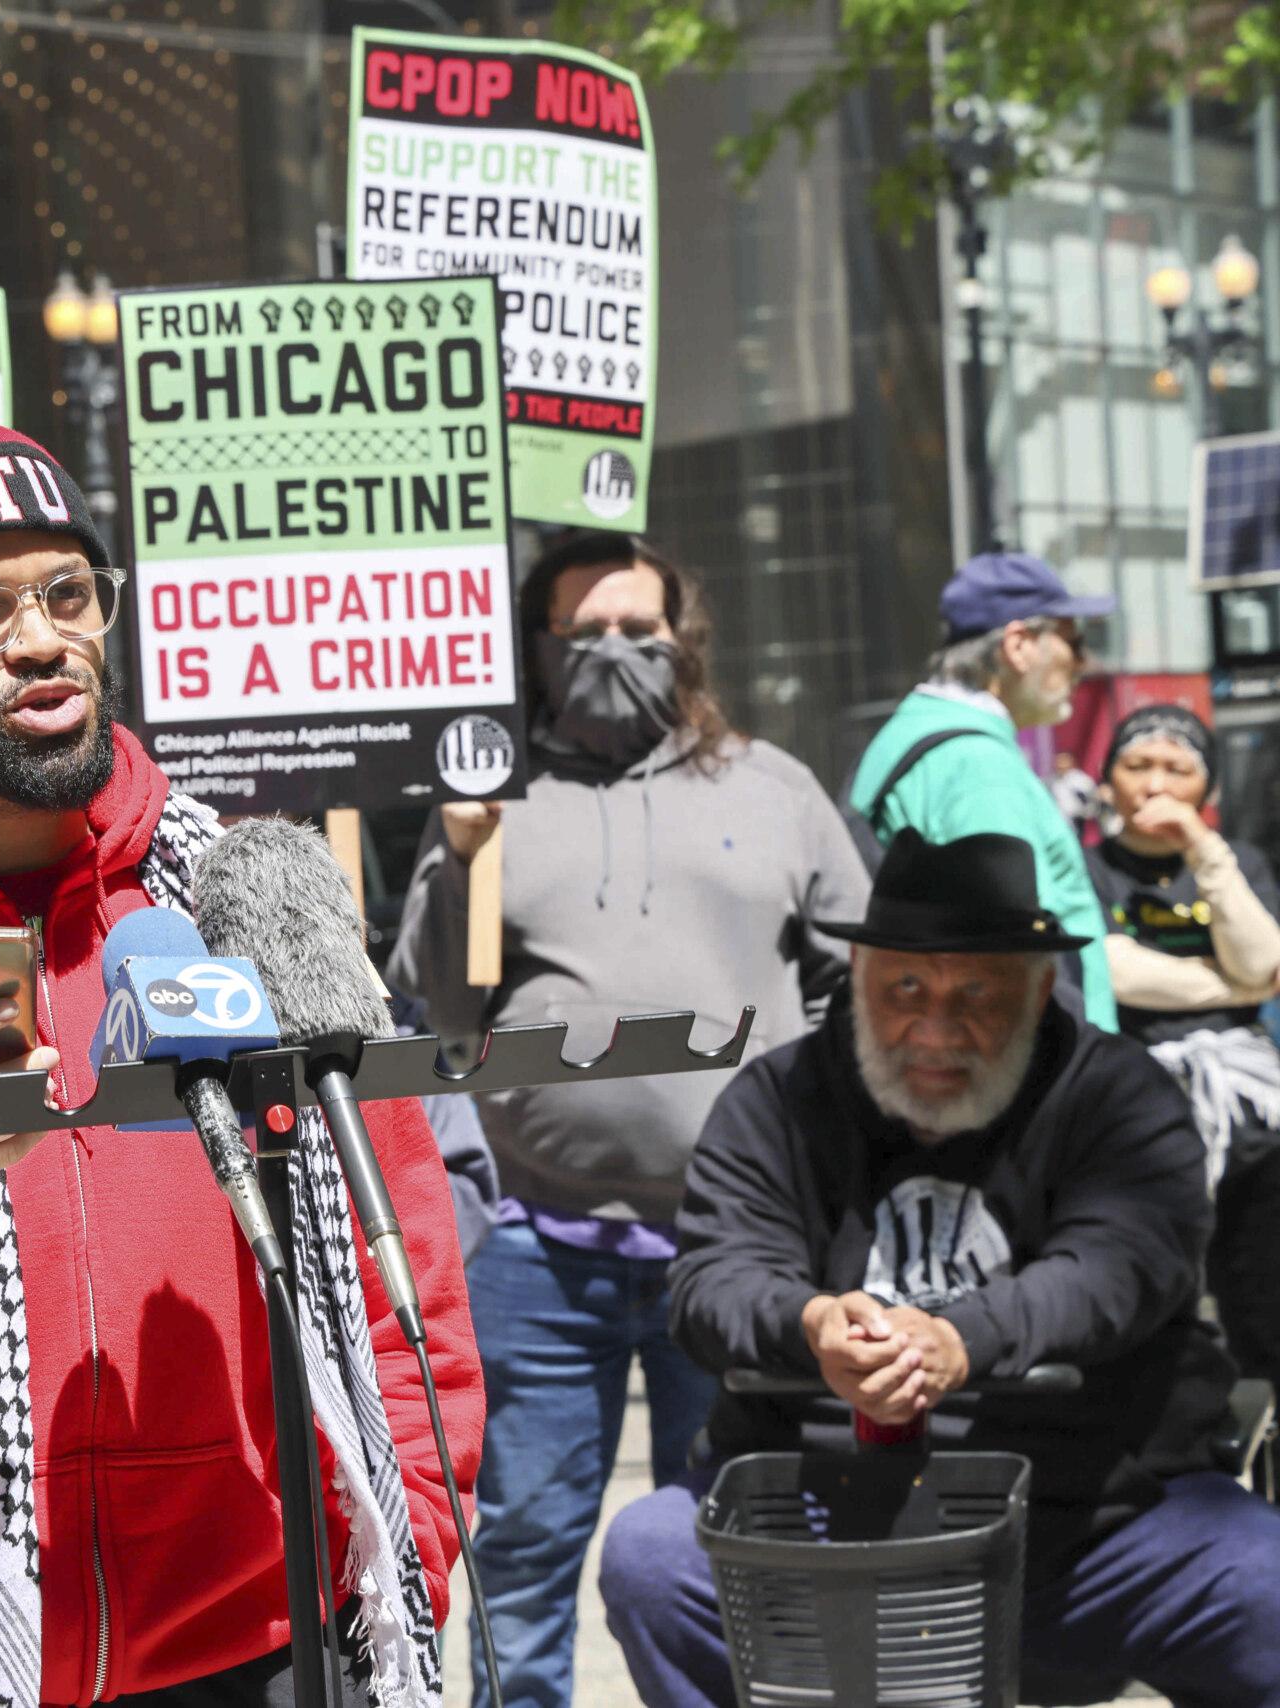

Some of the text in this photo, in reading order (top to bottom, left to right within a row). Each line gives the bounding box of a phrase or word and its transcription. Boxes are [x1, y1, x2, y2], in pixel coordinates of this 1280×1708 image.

[366, 50, 642, 140] CPOP NOW!
[364, 133, 642, 202] SUPPORT THE
[363, 186, 642, 257] REFERENDUM
[361, 241, 643, 292] FOR COMMUNITY POWER
[137, 302, 242, 340] FROM
[137, 338, 485, 423] CHICAGO
[525, 394, 564, 424] THE
[567, 400, 642, 433] PEOPLE
[441, 425, 487, 460] TO
[144, 472, 492, 545] PALESTINE
[152, 568, 493, 632] OCCUPATION
[158, 633, 494, 700] IS A CRIME!
[154, 722, 411, 754] Chicago Alliance Against Racist
[191, 753, 260, 775] Political
[261, 750, 356, 773] Repression
[148, 989, 194, 1005] abc
